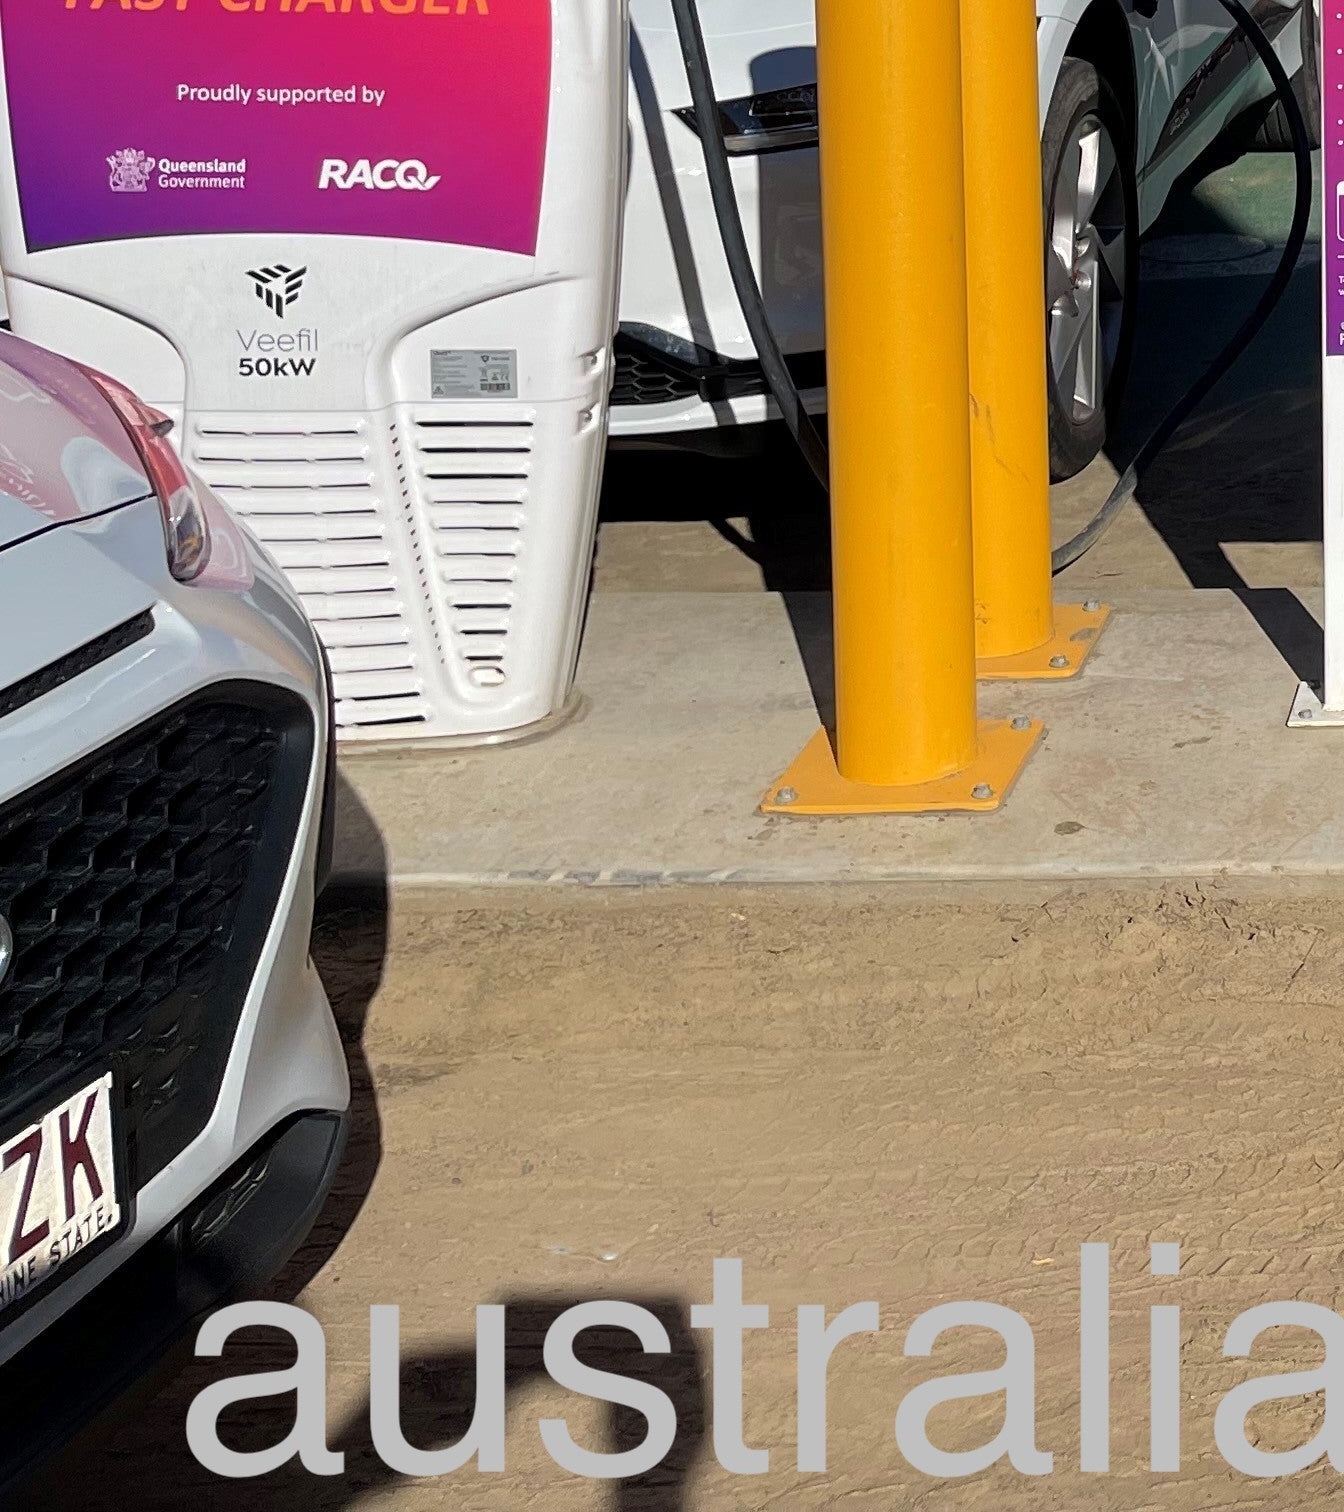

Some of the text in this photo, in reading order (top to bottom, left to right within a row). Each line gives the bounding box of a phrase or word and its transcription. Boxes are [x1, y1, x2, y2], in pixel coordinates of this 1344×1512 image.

[177, 84, 385, 106] Proudly supported by
[158, 158, 442, 190] Queensland RACQ
[158, 174, 245, 190] Government
[236, 329, 318, 352] Veefil
[239, 357, 316, 377] 50kW
[0, 1089, 103, 1265] ZK
[50, 1205, 104, 1266] STATE
